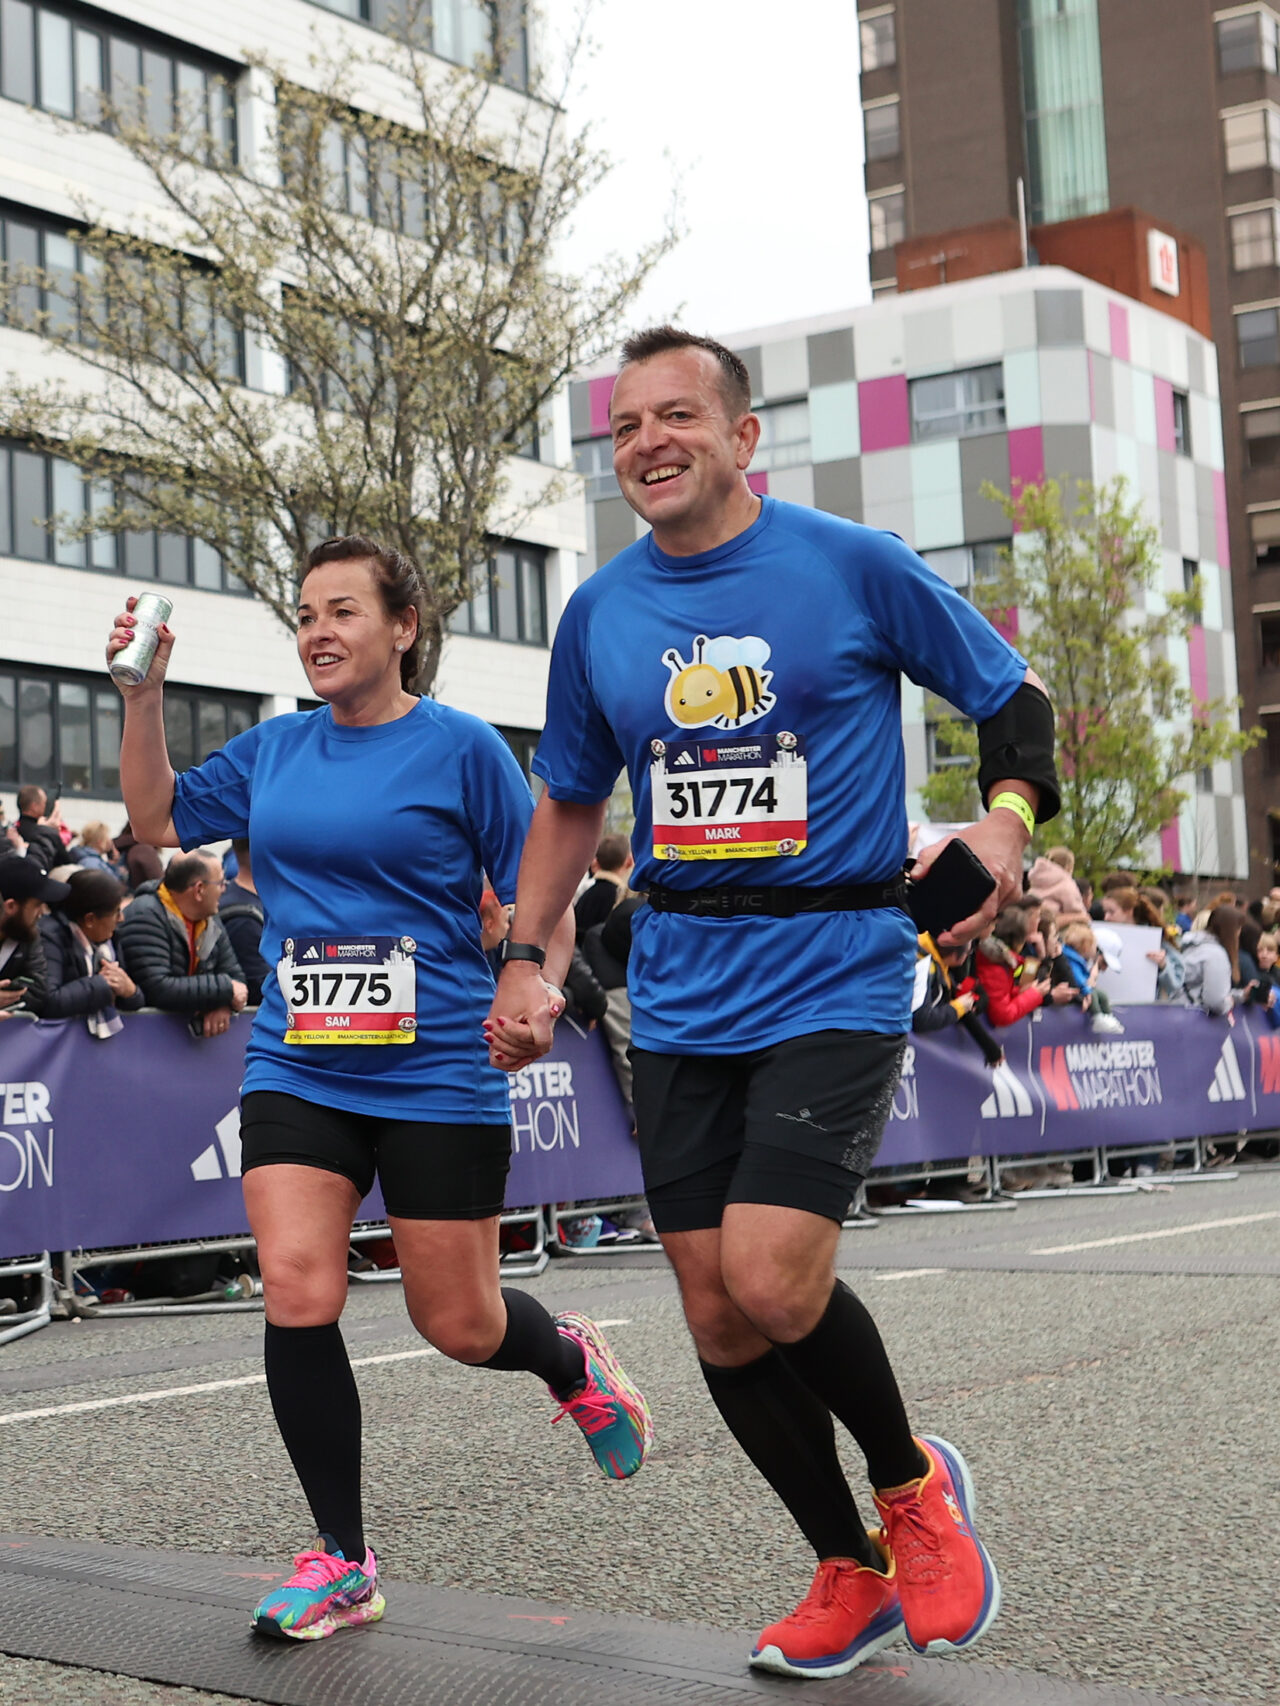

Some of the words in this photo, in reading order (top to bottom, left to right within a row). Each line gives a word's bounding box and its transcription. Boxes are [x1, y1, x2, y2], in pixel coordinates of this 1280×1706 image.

[717, 745, 762, 754] MANCHESTER
[717, 751, 763, 762] MARATHON
[666, 776, 778, 819] 31774
[705, 826, 742, 840] MARK
[337, 950, 376, 958] MARATHON
[290, 972, 392, 1007] 31775
[325, 1016, 350, 1027] SAM
[1065, 1040, 1156, 1072] MANCHESTER
[508, 1061, 575, 1100] ESTER
[1071, 1068, 1163, 1110] MARATHON
